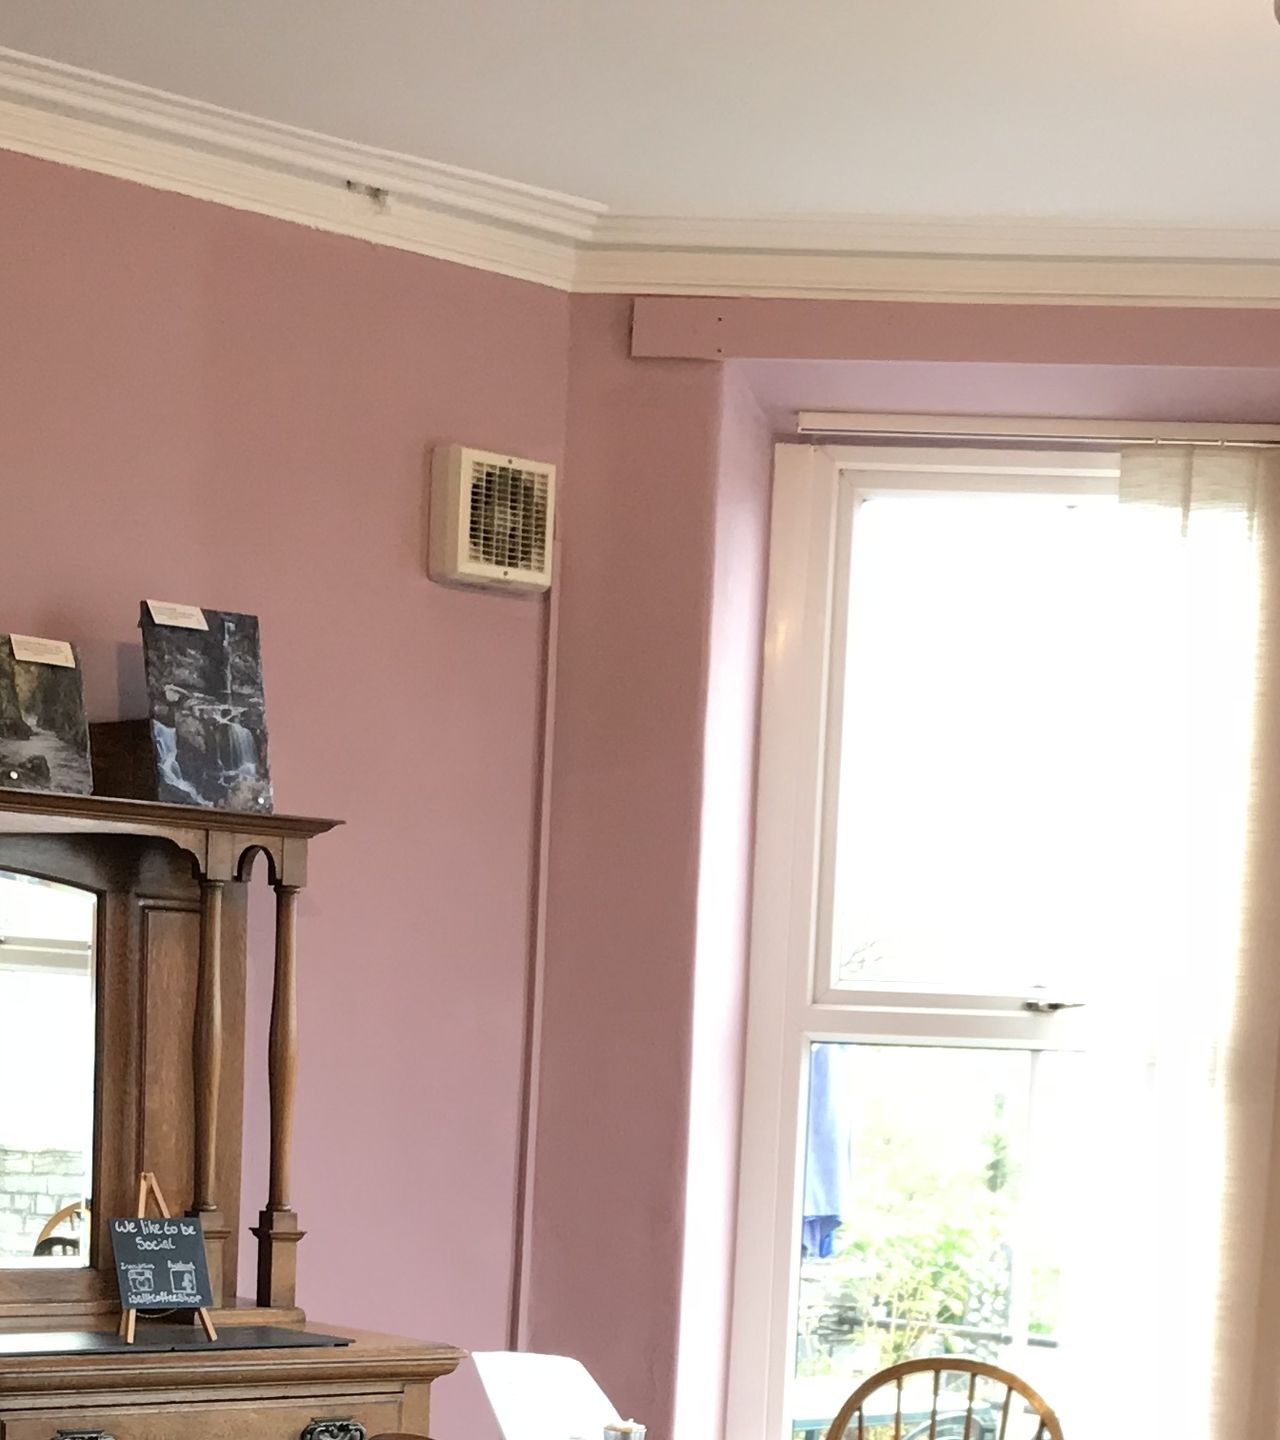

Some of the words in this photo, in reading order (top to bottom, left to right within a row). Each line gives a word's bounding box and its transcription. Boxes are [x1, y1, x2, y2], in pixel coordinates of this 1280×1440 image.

[115, 1220, 138, 1233] We
[141, 1219, 163, 1235] like
[163, 1221, 178, 1235] to
[180, 1222, 197, 1235] be
